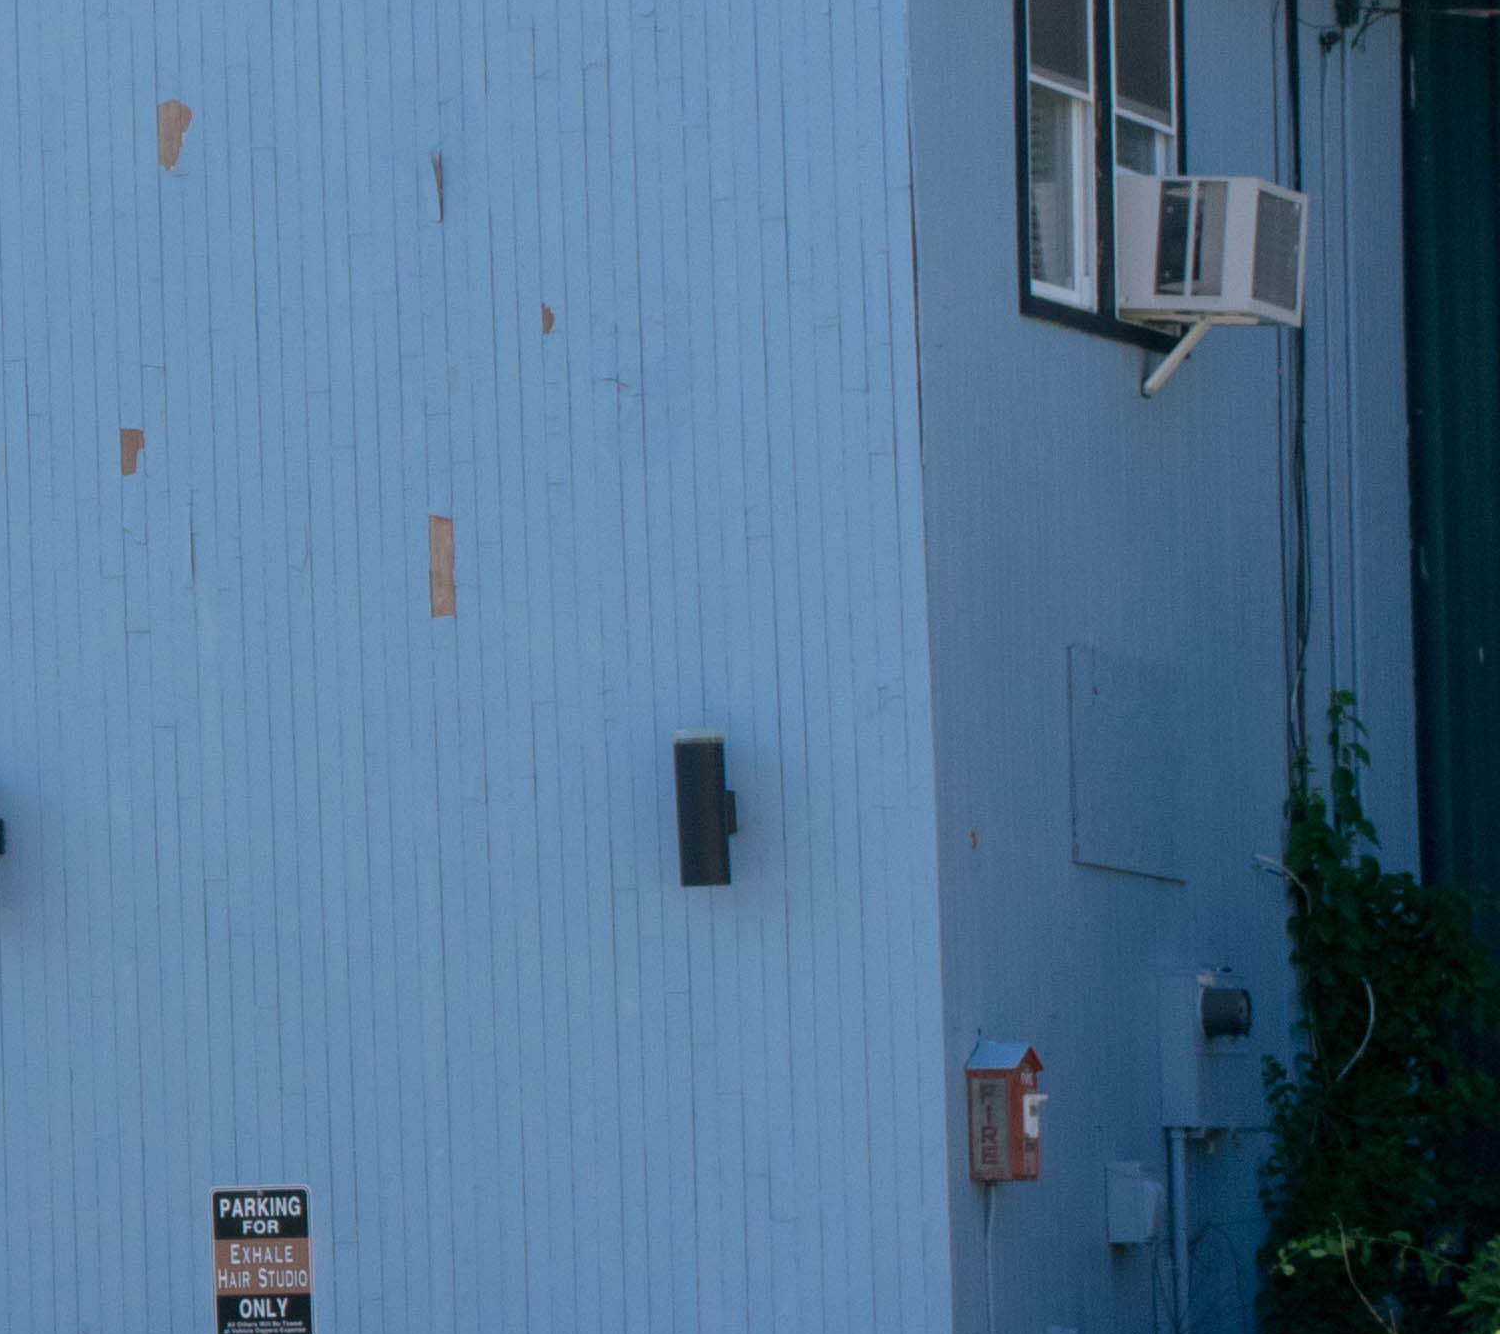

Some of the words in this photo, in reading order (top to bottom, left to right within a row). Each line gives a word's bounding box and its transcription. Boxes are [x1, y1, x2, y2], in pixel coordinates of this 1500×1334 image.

[980, 1083, 997, 1164] FIRE
[219, 1196, 301, 1217] PARKING
[242, 1219, 279, 1235] FOR
[230, 1244, 293, 1264] EXHALE
[218, 1268, 250, 1288] HAIR
[258, 1267, 308, 1288] STUDIO
[239, 1298, 289, 1318] ONLY
